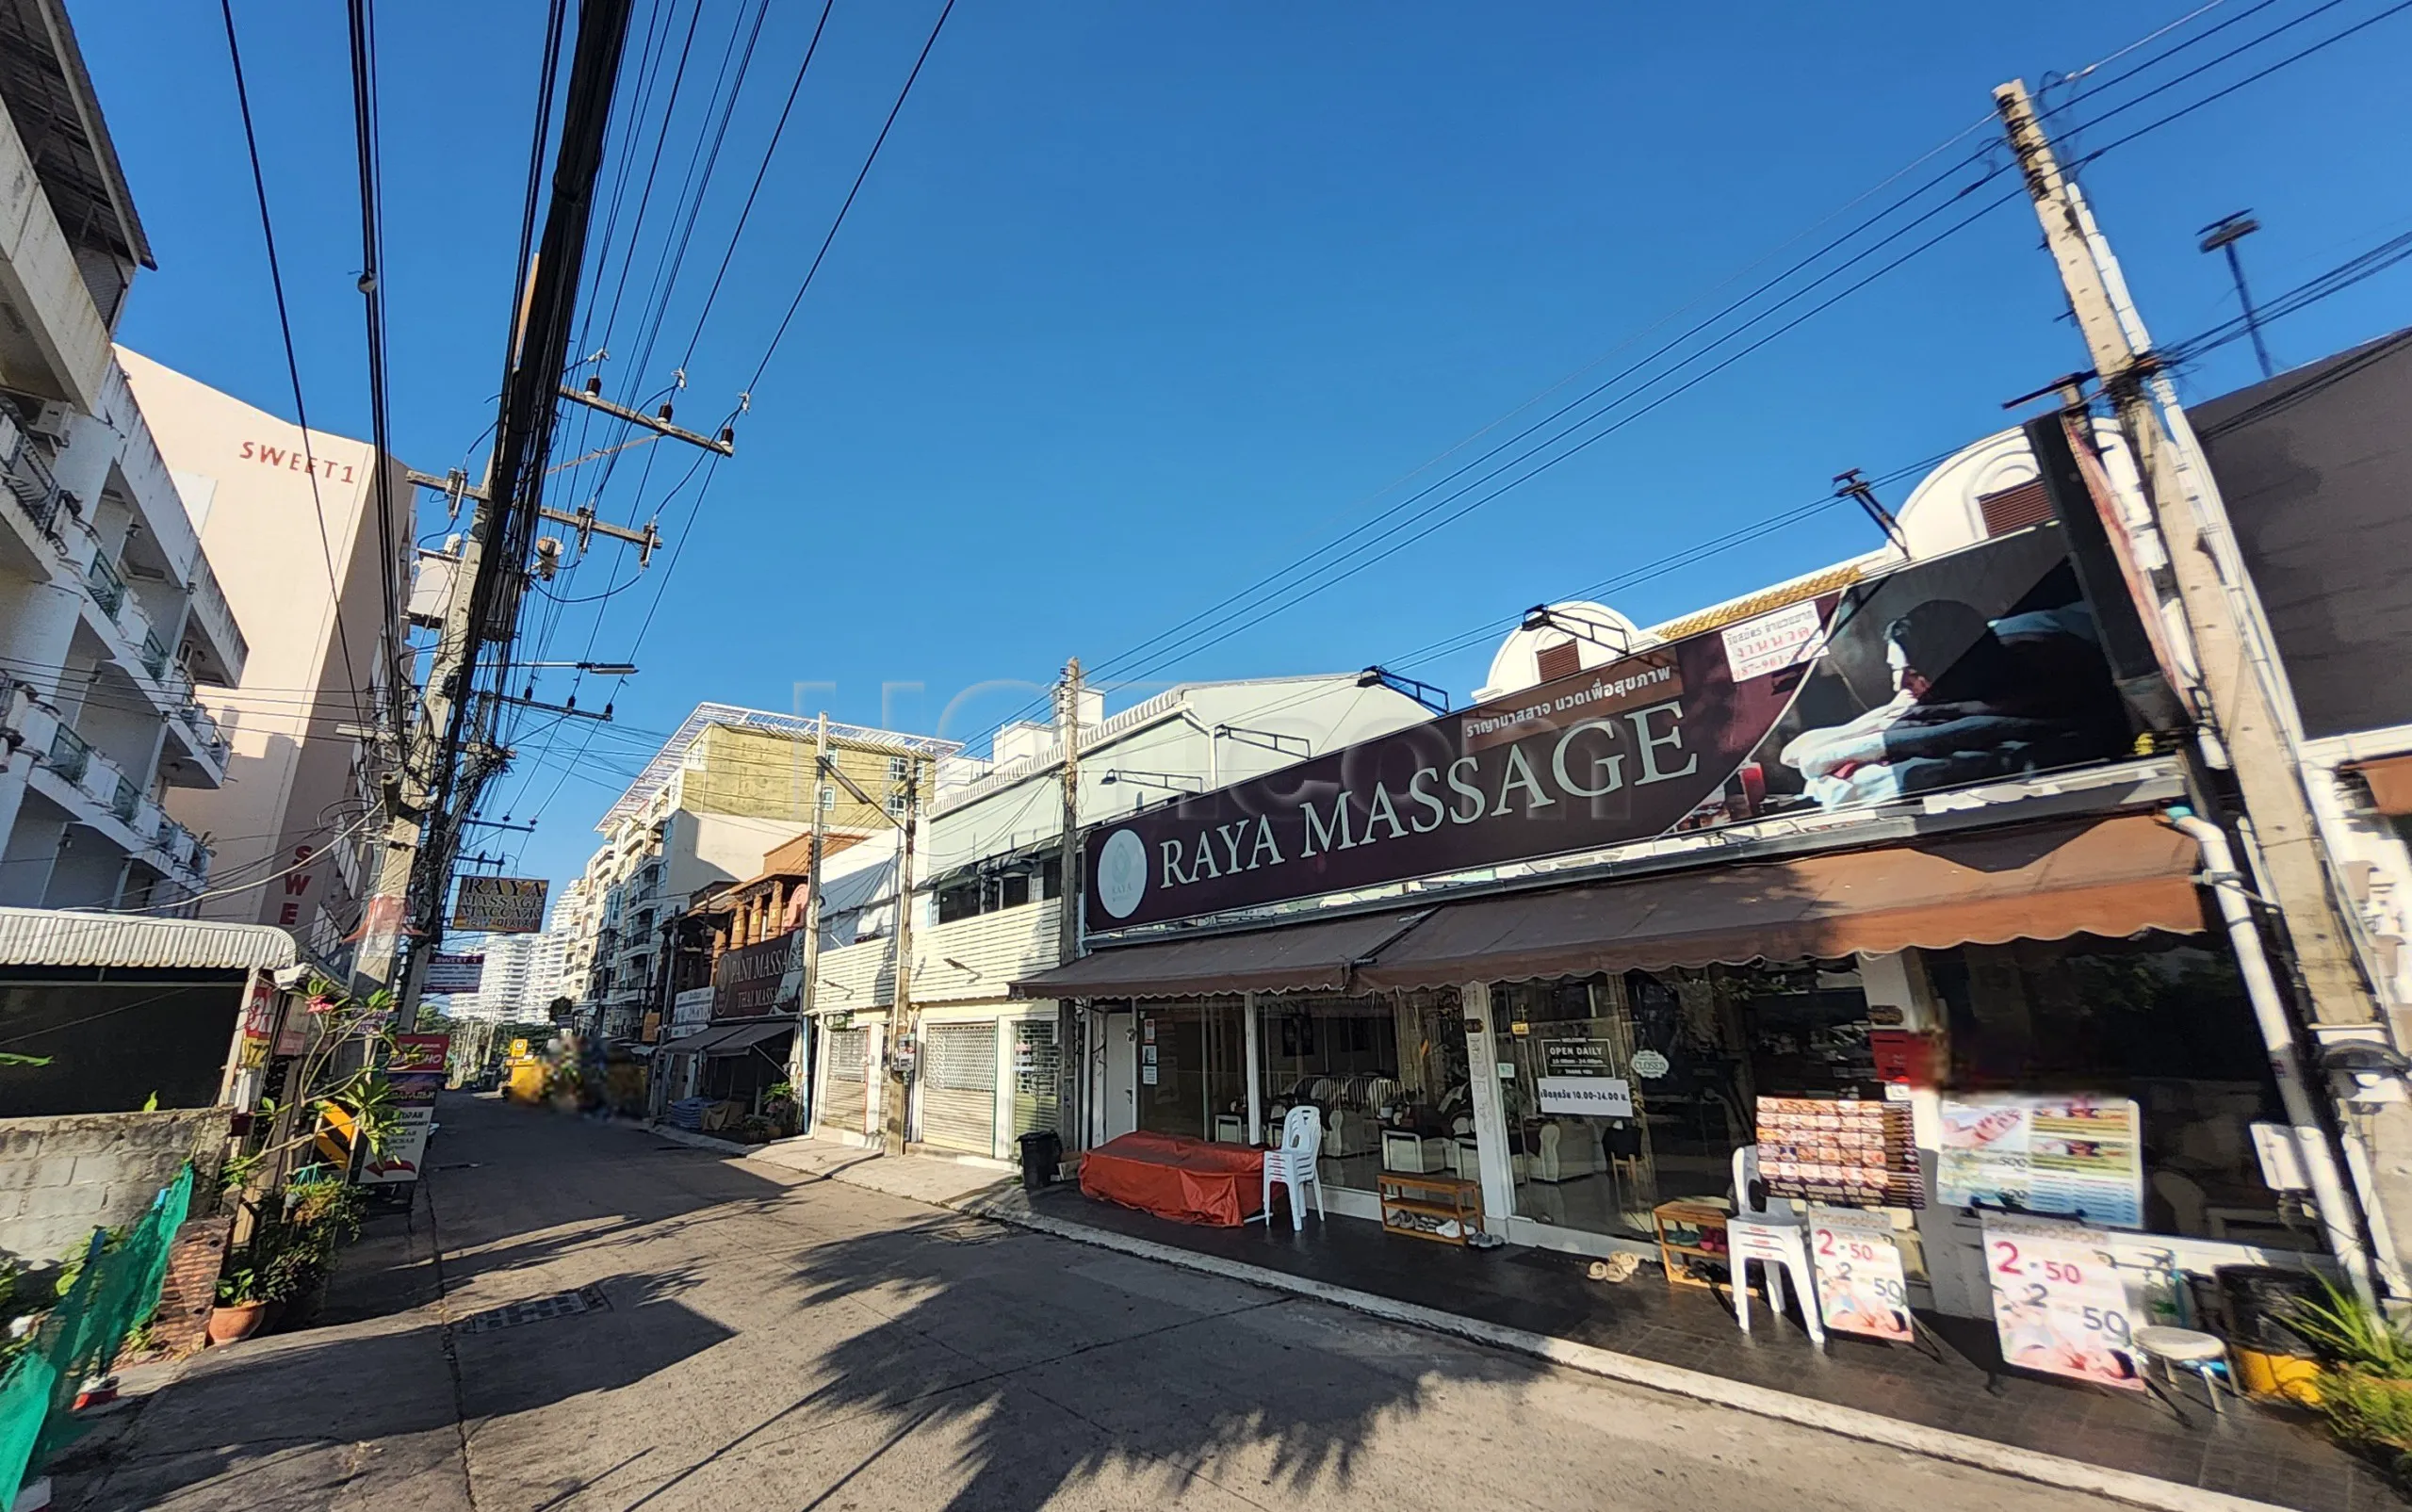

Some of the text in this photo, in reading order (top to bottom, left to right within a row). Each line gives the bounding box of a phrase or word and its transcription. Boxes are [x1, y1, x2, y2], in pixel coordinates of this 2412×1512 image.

[1555, 665, 1671, 713] นวดเพื่อสุขภาพ
[1159, 699, 1699, 890] RAYA MASSAGE
[465, 877, 544, 898] RAYA
[1112, 884, 1133, 895] RAYA
[463, 894, 545, 908] MASSAGE
[1550, 1047, 1602, 1055] OPEN DAILY
[1635, 1062, 1666, 1070] CLOSED
[1816, 1228, 1835, 1256] 2
[1850, 1244, 1873, 1260] 50
[1994, 1241, 2081, 1284] 2 50
